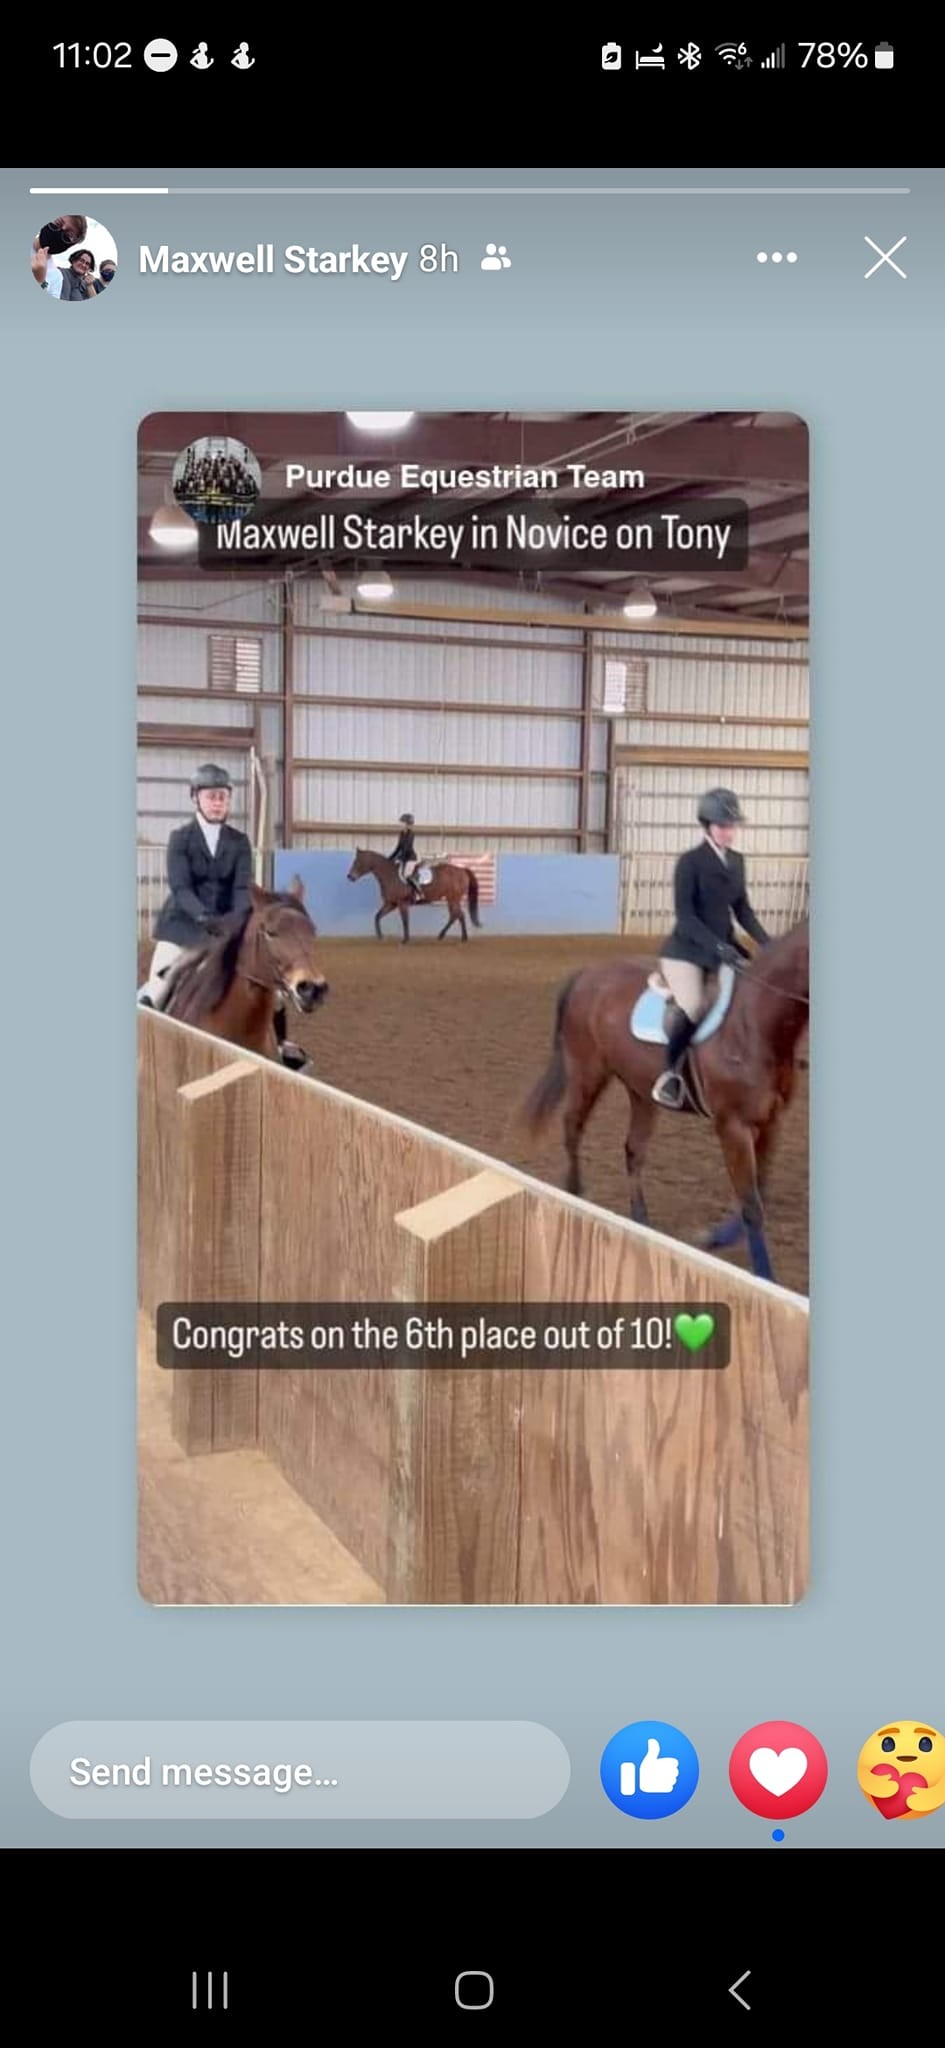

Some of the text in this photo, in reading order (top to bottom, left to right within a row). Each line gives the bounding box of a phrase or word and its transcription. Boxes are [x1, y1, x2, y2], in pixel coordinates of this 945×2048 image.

[52, 41, 132, 69] 11:02
[797, 41, 869, 69] 78%
[140, 243, 459, 281] Maxwell Starkey 8h
[69, 1756, 151, 1786] Send
